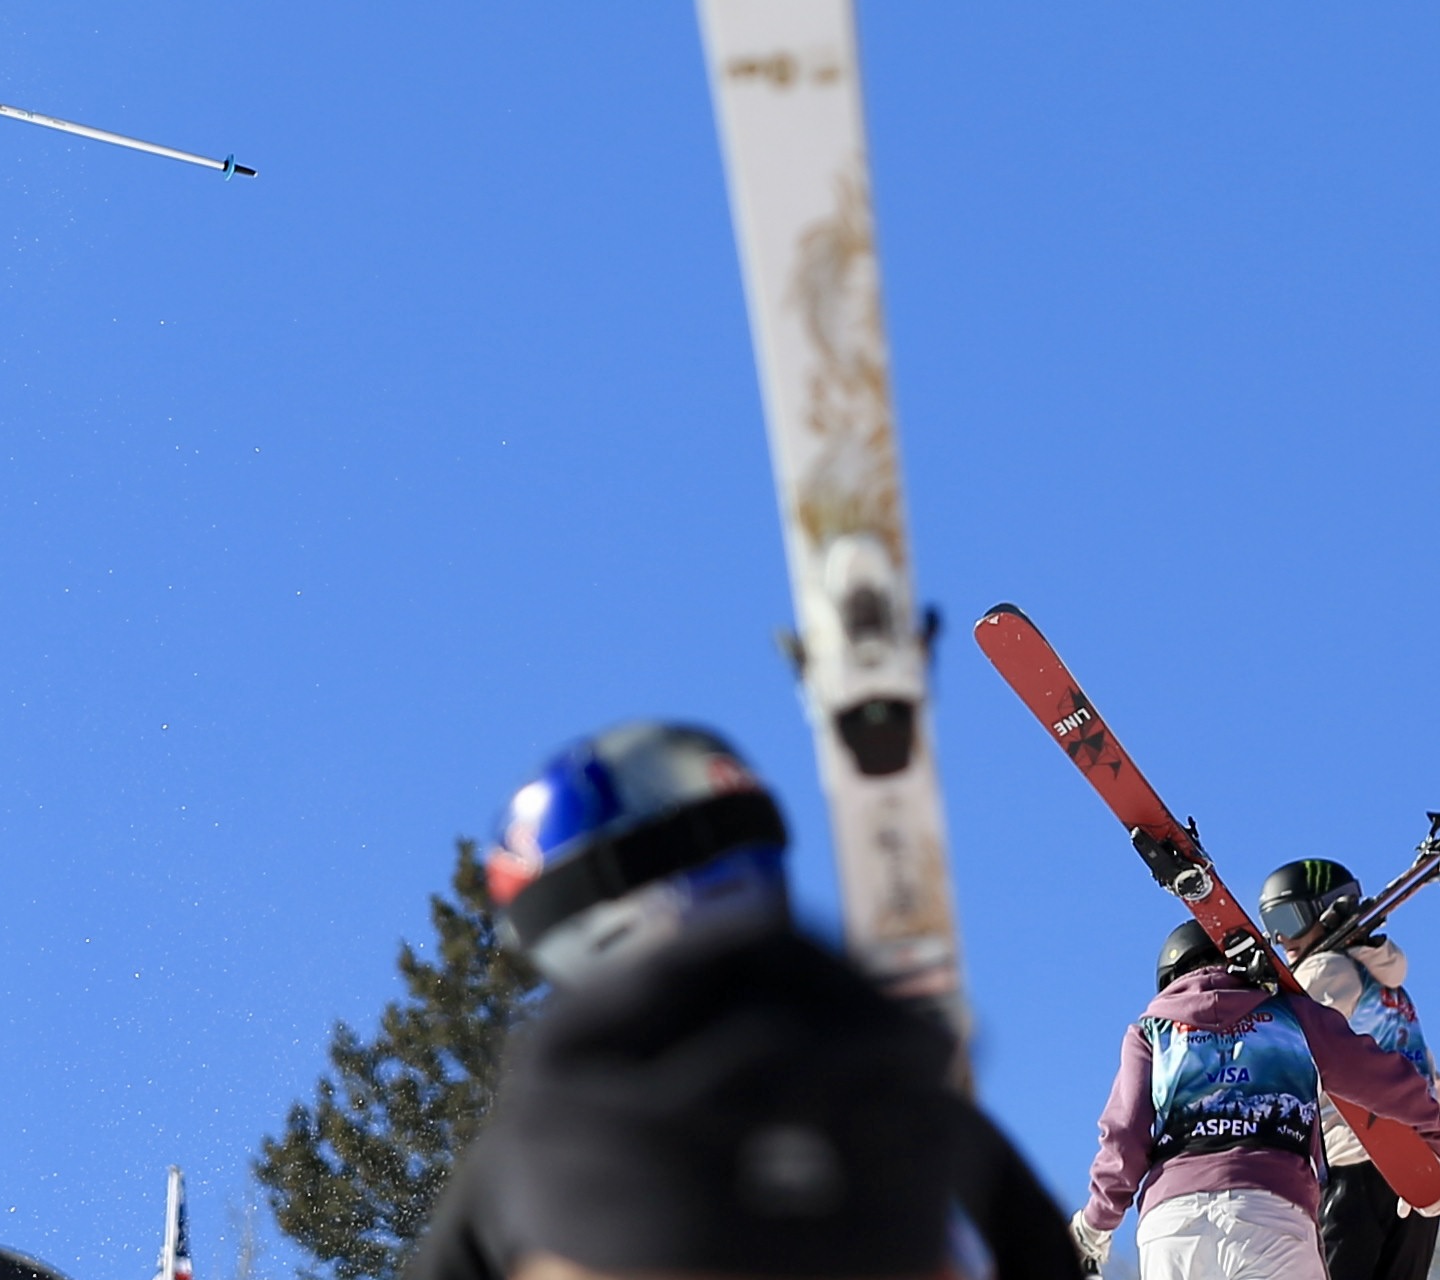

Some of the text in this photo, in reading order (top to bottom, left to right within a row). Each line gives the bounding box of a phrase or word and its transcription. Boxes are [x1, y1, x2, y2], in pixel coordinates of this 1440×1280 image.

[1053, 707, 1092, 737] LINE
[1206, 1067, 1251, 1083] VISA
[1191, 1119, 1258, 1137] ASPEN
